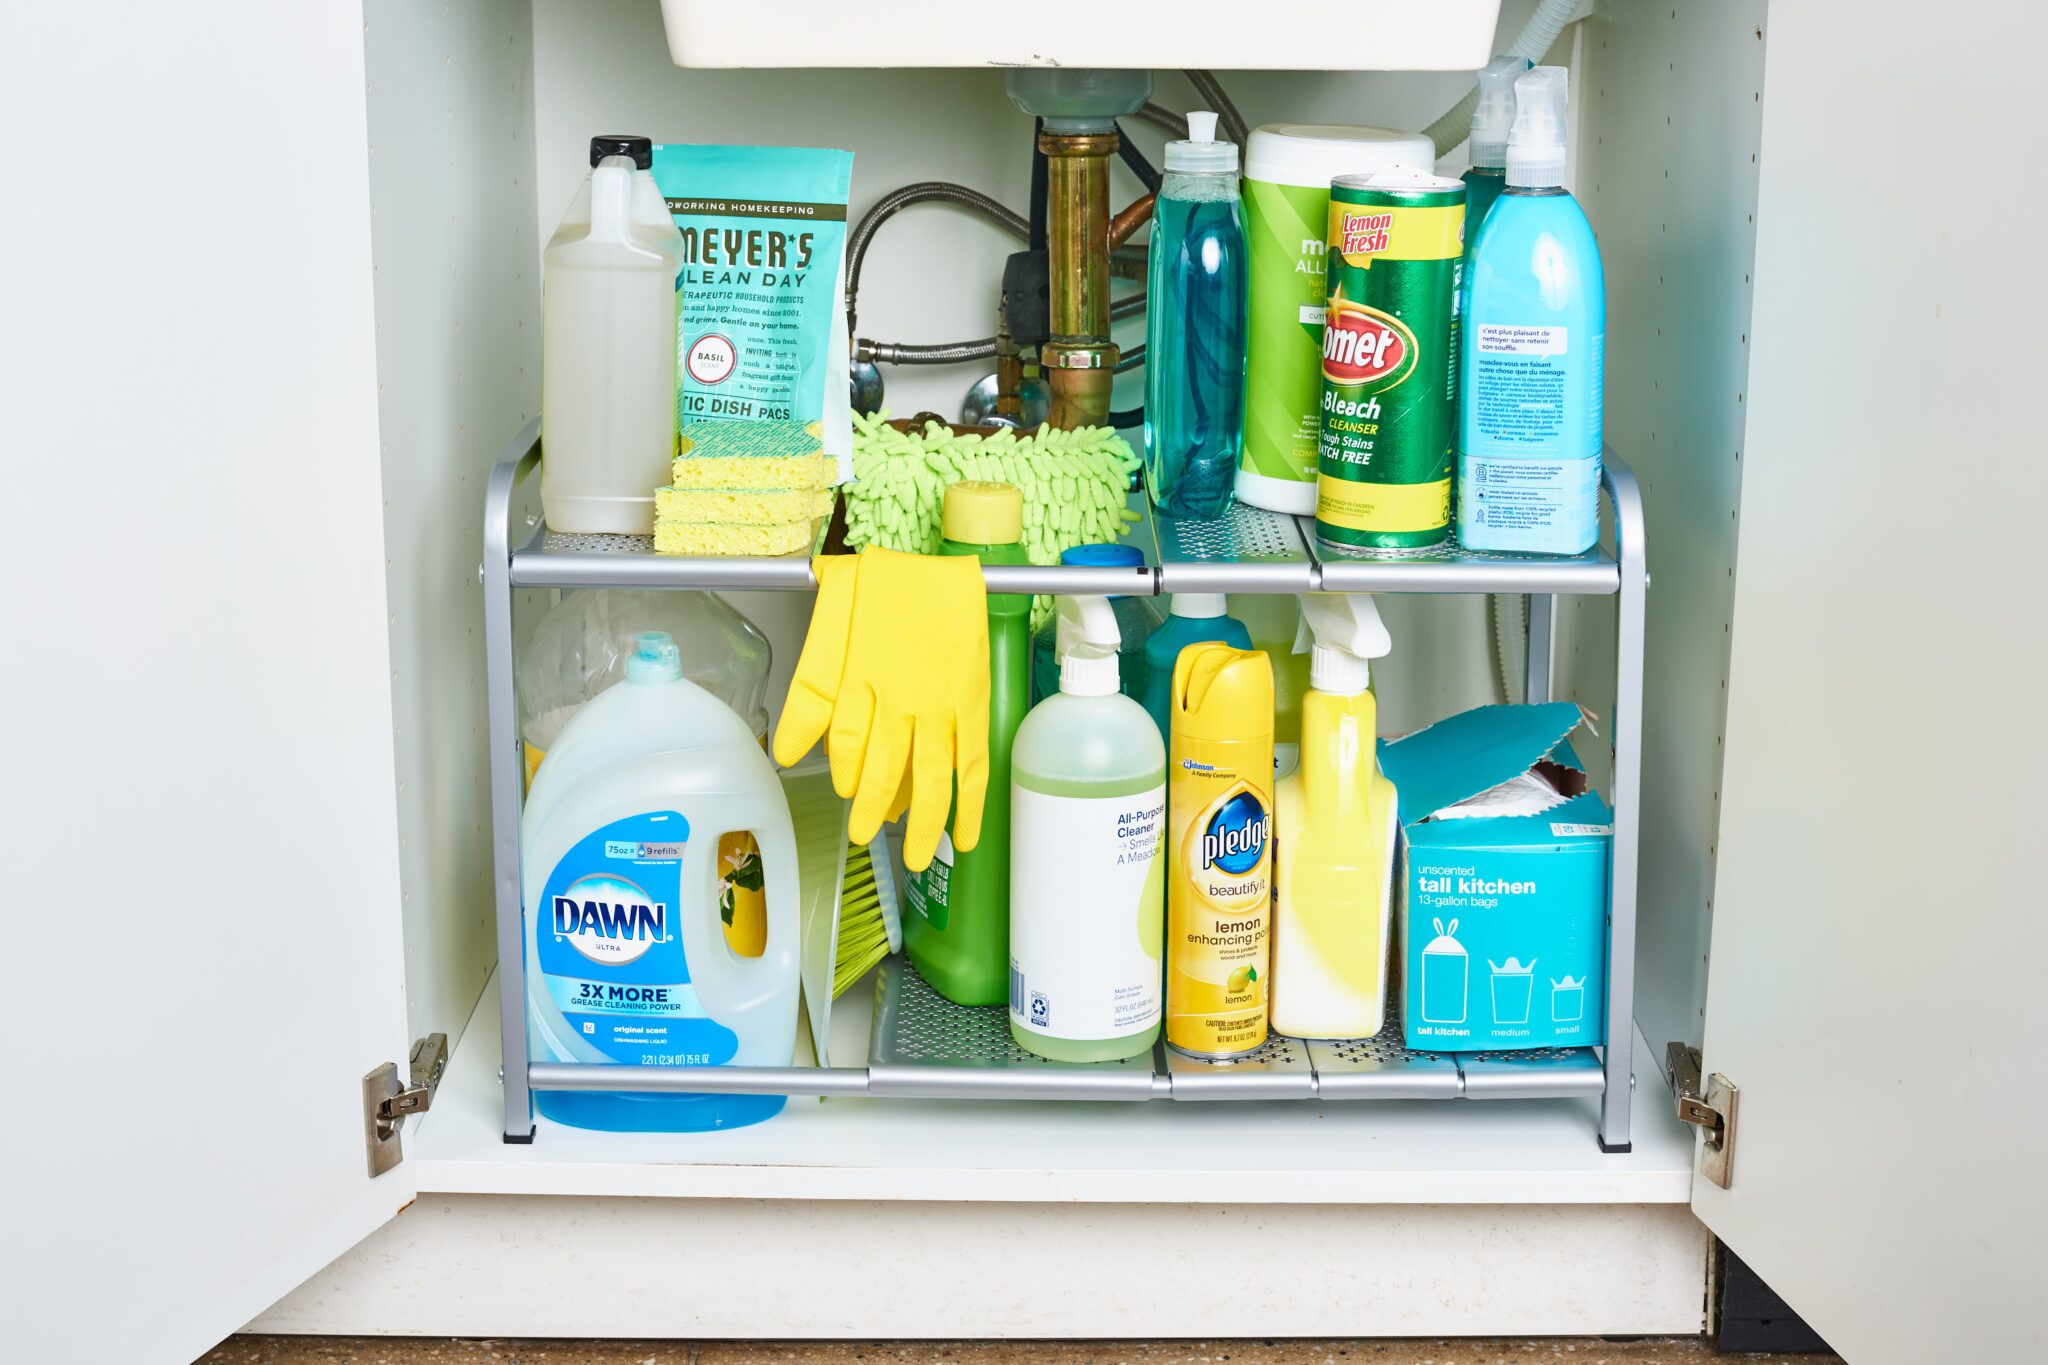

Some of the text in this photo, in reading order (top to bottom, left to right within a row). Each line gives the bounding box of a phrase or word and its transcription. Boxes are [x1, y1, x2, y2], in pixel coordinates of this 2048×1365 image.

[731, 204, 814, 215] HOMEKEEPING
[1343, 213, 1392, 232] Lemon
[1342, 230, 1389, 254] Fresh
[687, 270, 807, 288] LEAN DAY
[736, 292, 774, 304] HOUSEHOLD
[776, 296, 804, 304] PRODUCTS
[706, 304, 730, 313] happy
[732, 306, 760, 315] homes
[695, 316, 718, 324] grime.
[720, 317, 748, 326] Gentle
[698, 352, 725, 362] BASIL
[746, 348, 772, 358] INVITING
[711, 398, 752, 416] DISH
[758, 407, 790, 420] PACS
[1324, 390, 1382, 420] Bleach
[1330, 418, 1378, 435] CLEANSER
[1322, 429, 1340, 446] Tough
[1342, 436, 1374, 450] Stains
[1341, 450, 1374, 466] FREE
[1117, 822, 1154, 838] Cleaner
[1129, 834, 1156, 850] Smells
[1203, 813, 1270, 870] pledge
[608, 845, 628, 854] 75oz
[1116, 854, 1125, 866] A
[1418, 865, 1475, 876] unscented
[1419, 876, 1536, 894] tall kitchen
[1418, 894, 1498, 909] 13-gallon bags
[554, 896, 665, 942] DAWN
[1216, 918, 1261, 933] lemon
[1188, 932, 1252, 946] enhancing
[596, 944, 621, 952] ULTRA
[580, 984, 604, 999] 3X
[571, 998, 681, 1011] GREASE CLEANING POWER
[1225, 994, 1252, 1004] lemon
[614, 1026, 644, 1034] original
[1418, 1026, 1470, 1037] tall kitchen
[1491, 1028, 1530, 1037] medium
[1554, 1025, 1580, 1035] small
[686, 1054, 693, 1064] 75
